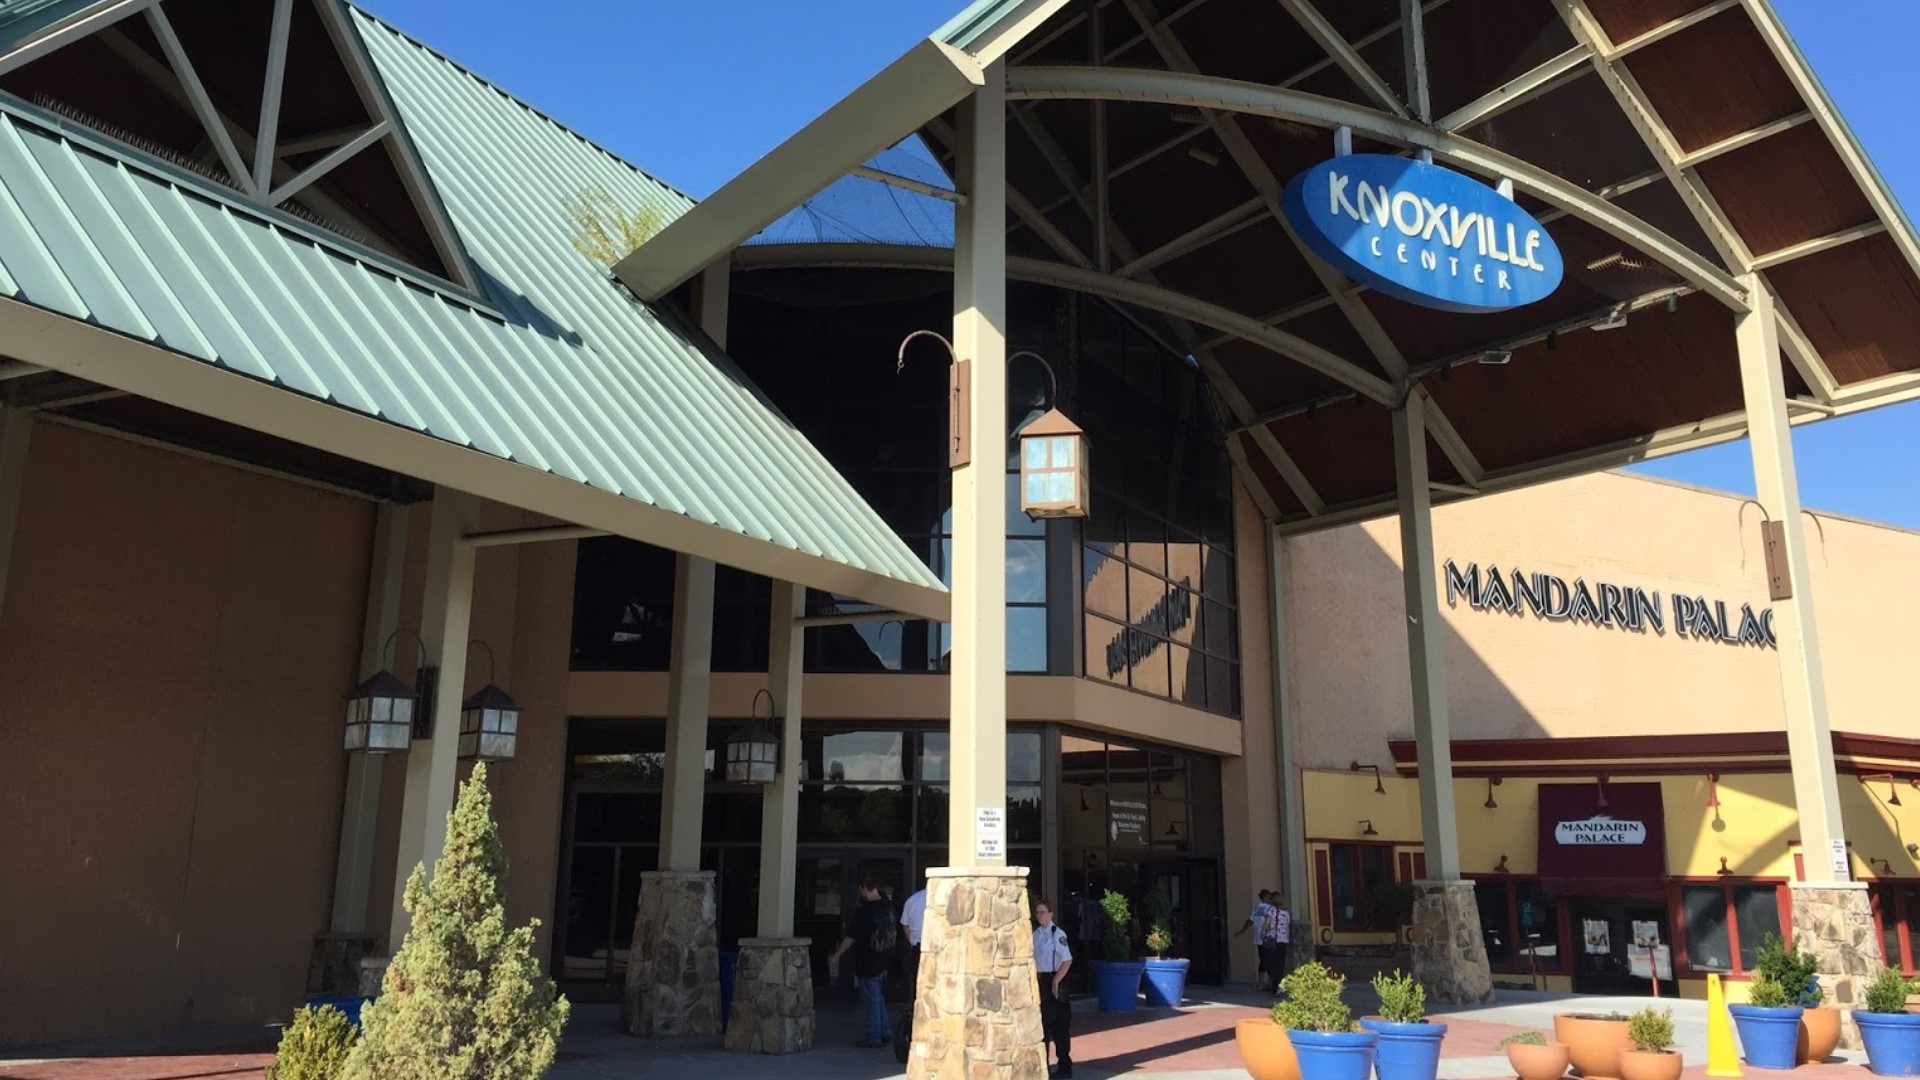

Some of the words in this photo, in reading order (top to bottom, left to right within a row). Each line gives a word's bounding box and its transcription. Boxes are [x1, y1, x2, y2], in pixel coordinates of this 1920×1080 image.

[1328, 170, 1544, 272] KNOXVILLE
[1371, 235, 1512, 291] CENTER
[1444, 557, 1666, 633] MANDARIN
[1672, 592, 1778, 651] PALAC
[1561, 823, 1639, 832] MANDARIN
[1575, 833, 1626, 842] PALACE
